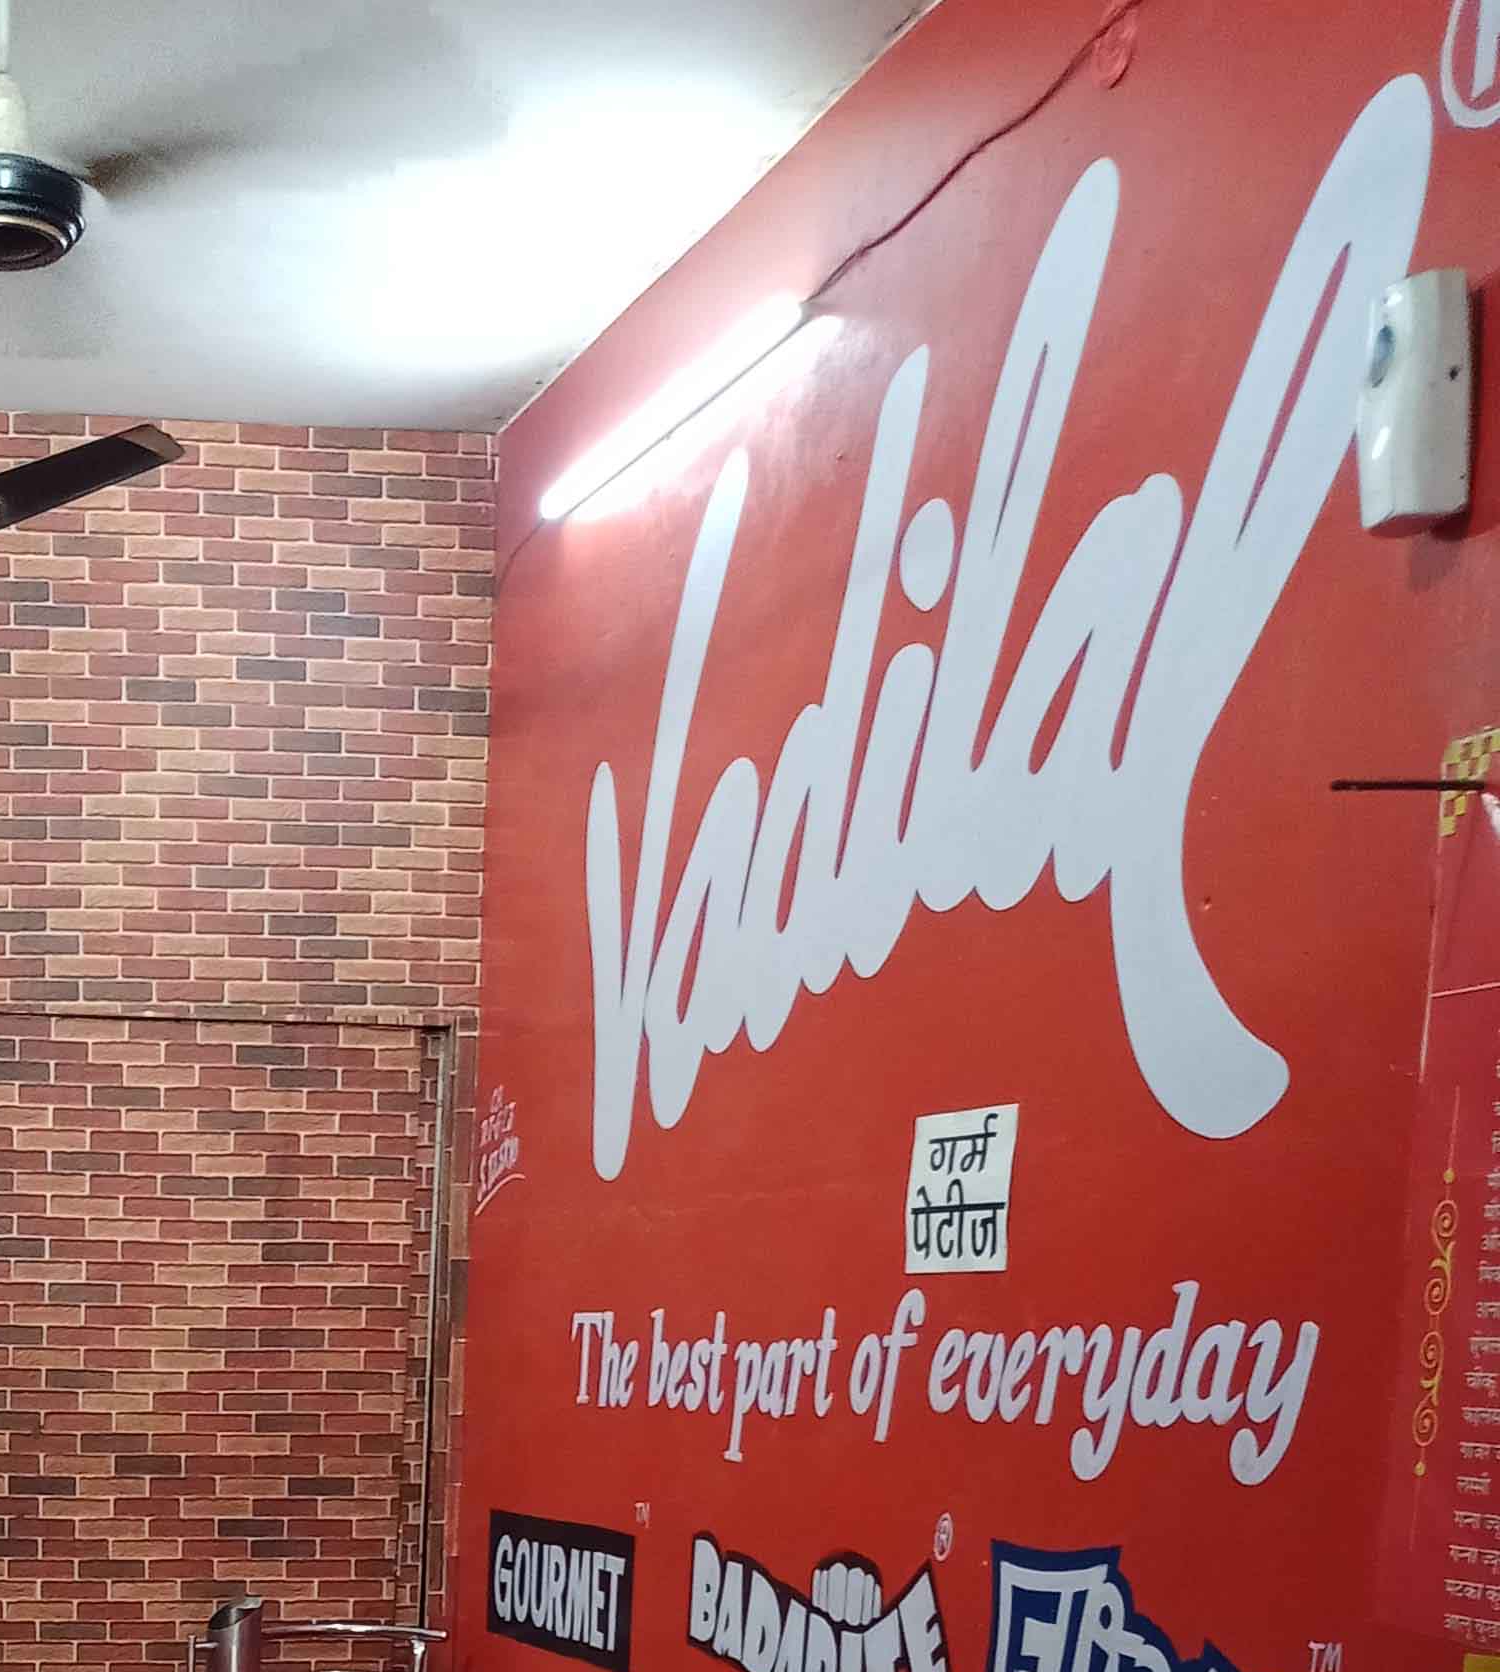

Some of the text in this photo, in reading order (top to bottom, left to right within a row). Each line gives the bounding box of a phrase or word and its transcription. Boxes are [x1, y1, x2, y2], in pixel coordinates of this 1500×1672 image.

[587, 73, 1431, 1181] Vadilal
[929, 1112, 999, 1175] गर्म
[910, 1178, 1006, 1259] पेटीज
[572, 1279, 1321, 1487] The best part of everyday
[494, 1534, 626, 1653] GOURMET
